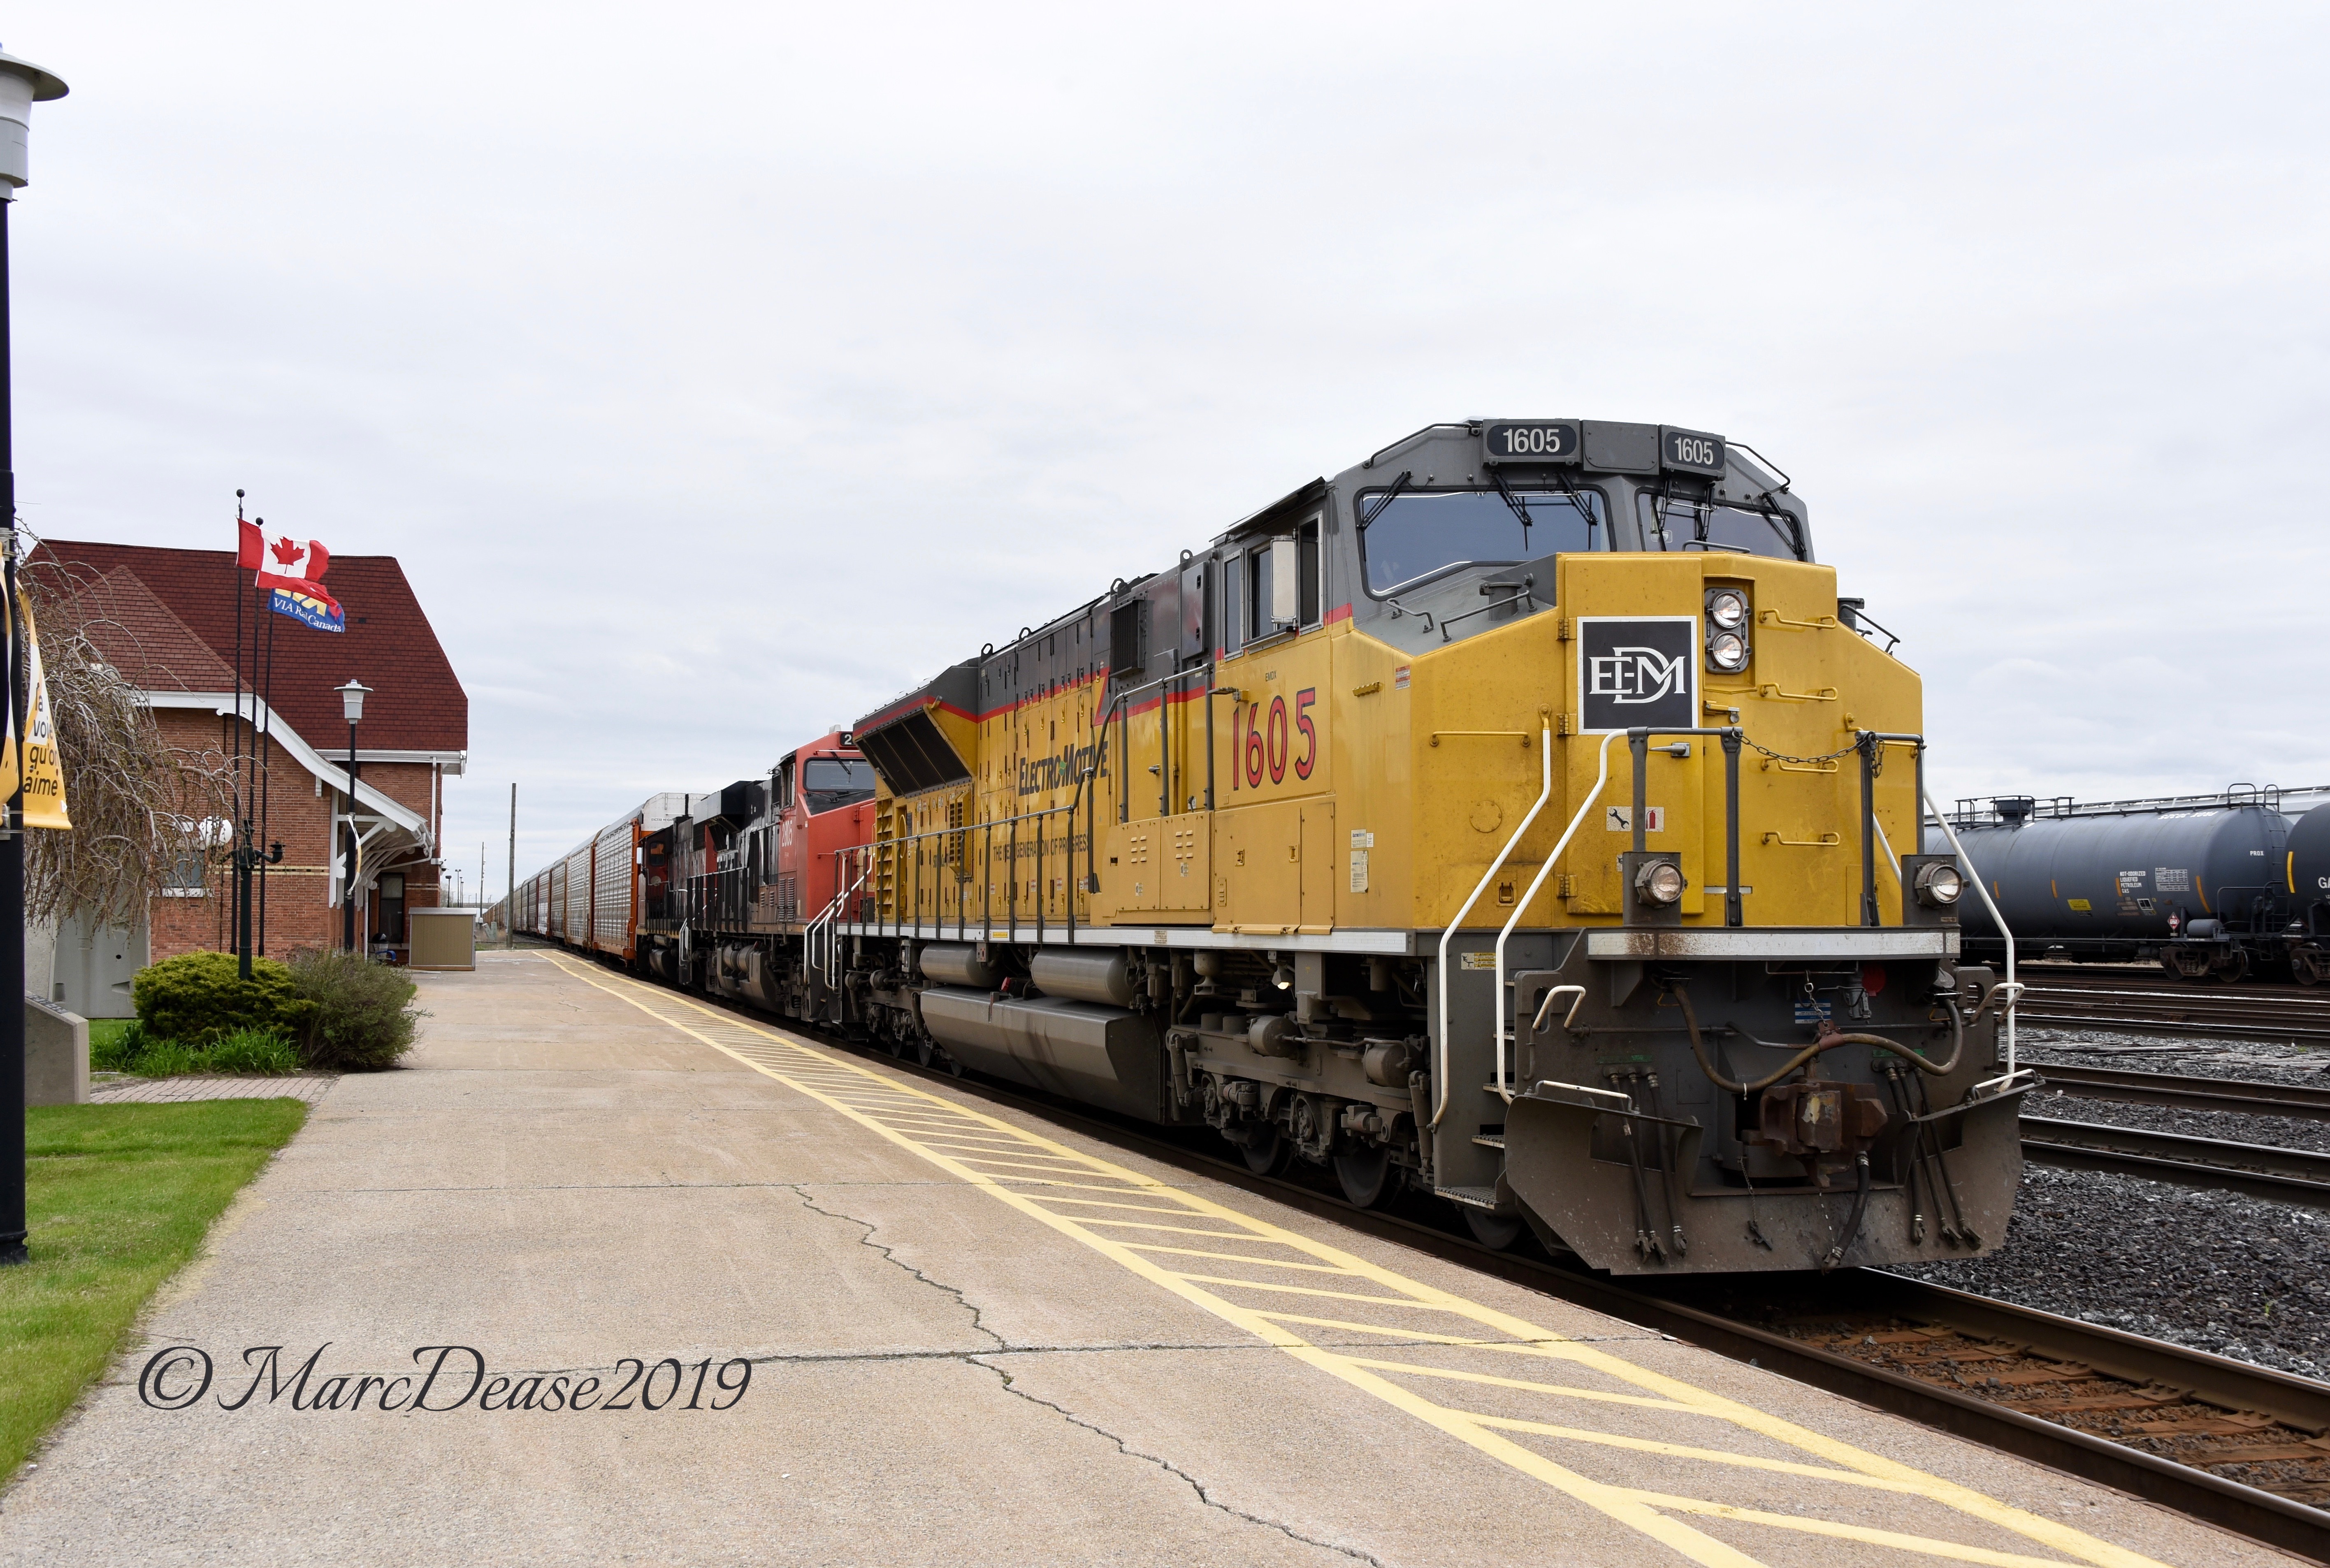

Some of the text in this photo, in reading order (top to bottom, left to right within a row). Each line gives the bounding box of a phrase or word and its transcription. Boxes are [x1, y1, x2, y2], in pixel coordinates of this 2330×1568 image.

[1503, 429, 1560, 452] 1605
[1675, 437, 1713, 465] 1605
[274, 597, 292, 612] VIA
[295, 605, 308, 621] Rail
[308, 615, 341, 632] Canada
[1265, 670, 1276, 682] EMDX
[35, 687, 43, 712] la
[33, 716, 53, 740] voie
[1233, 687, 1316, 791] 1605
[29, 743, 60, 769] qu'on
[23, 770, 58, 796] aime
[782, 820, 792, 847] 2805
[993, 845, 1002, 862] THE
[1016, 839, 1049, 858] GENERAON
[1051, 837, 1058, 856] OF
